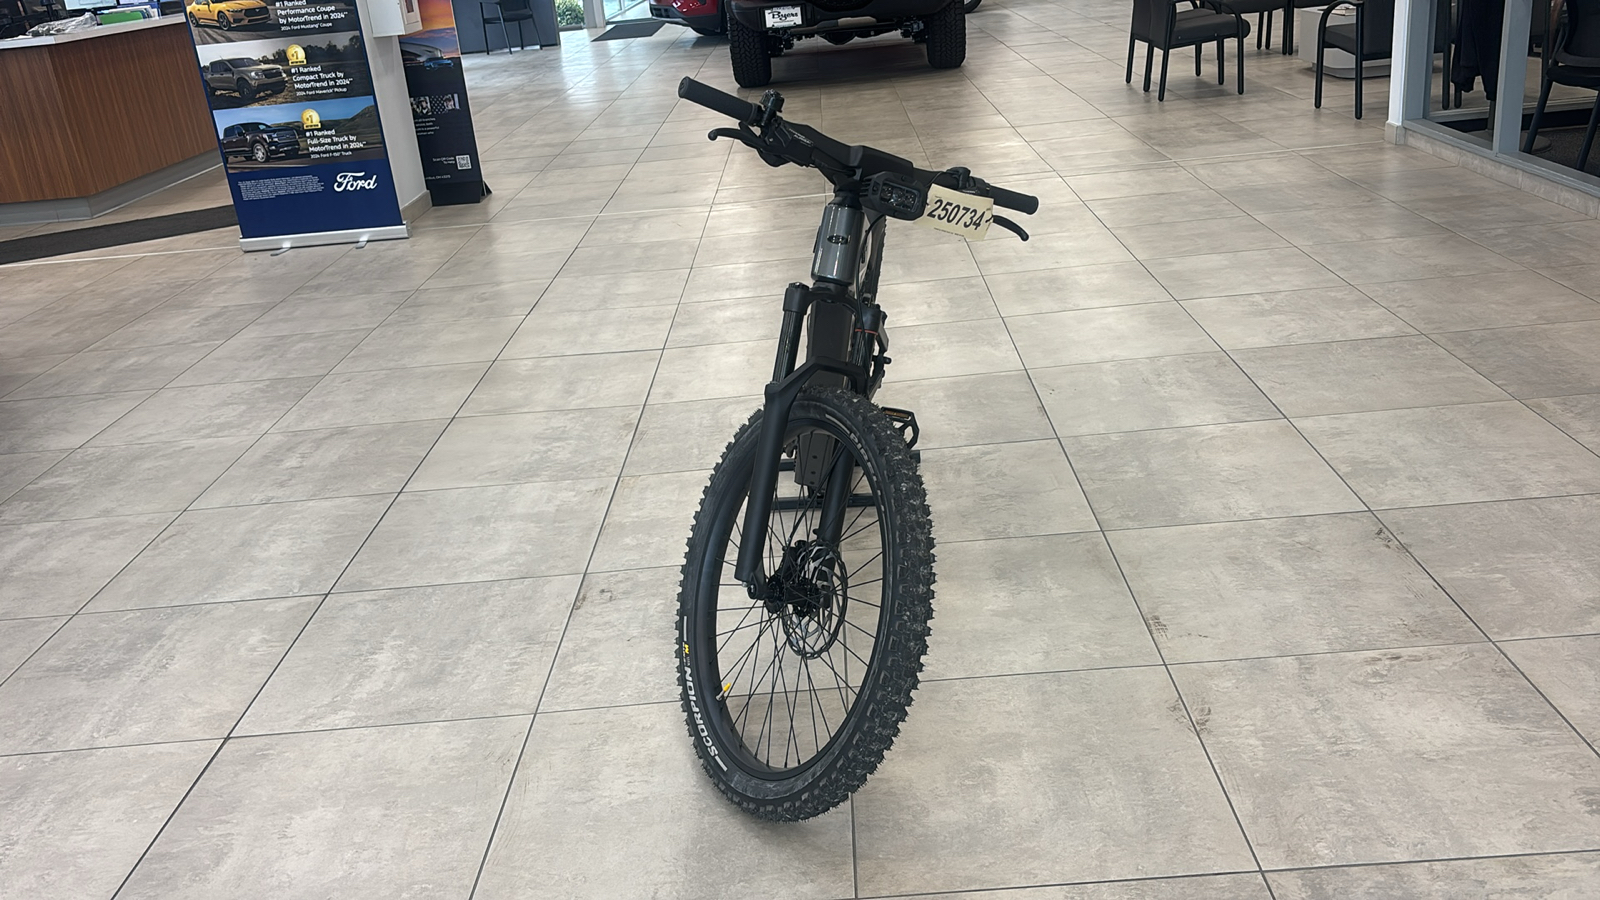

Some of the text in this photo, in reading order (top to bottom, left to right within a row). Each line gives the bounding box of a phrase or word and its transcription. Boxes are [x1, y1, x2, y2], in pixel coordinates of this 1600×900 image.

[277, 5, 336, 15] Performance Coupe
[288, 14, 322, 23] MotorTrend
[299, 65, 321, 73] Ranked
[293, 74, 319, 82] Compact
[294, 81, 328, 89] MotorTrend
[307, 137, 332, 145] Full-Size
[332, 134, 348, 142] Truck
[308, 144, 342, 152] MotorTrend
[333, 171, 377, 192] Ford
[927, 199, 986, 231] 250734
[684, 666, 719, 757] SCORPION
